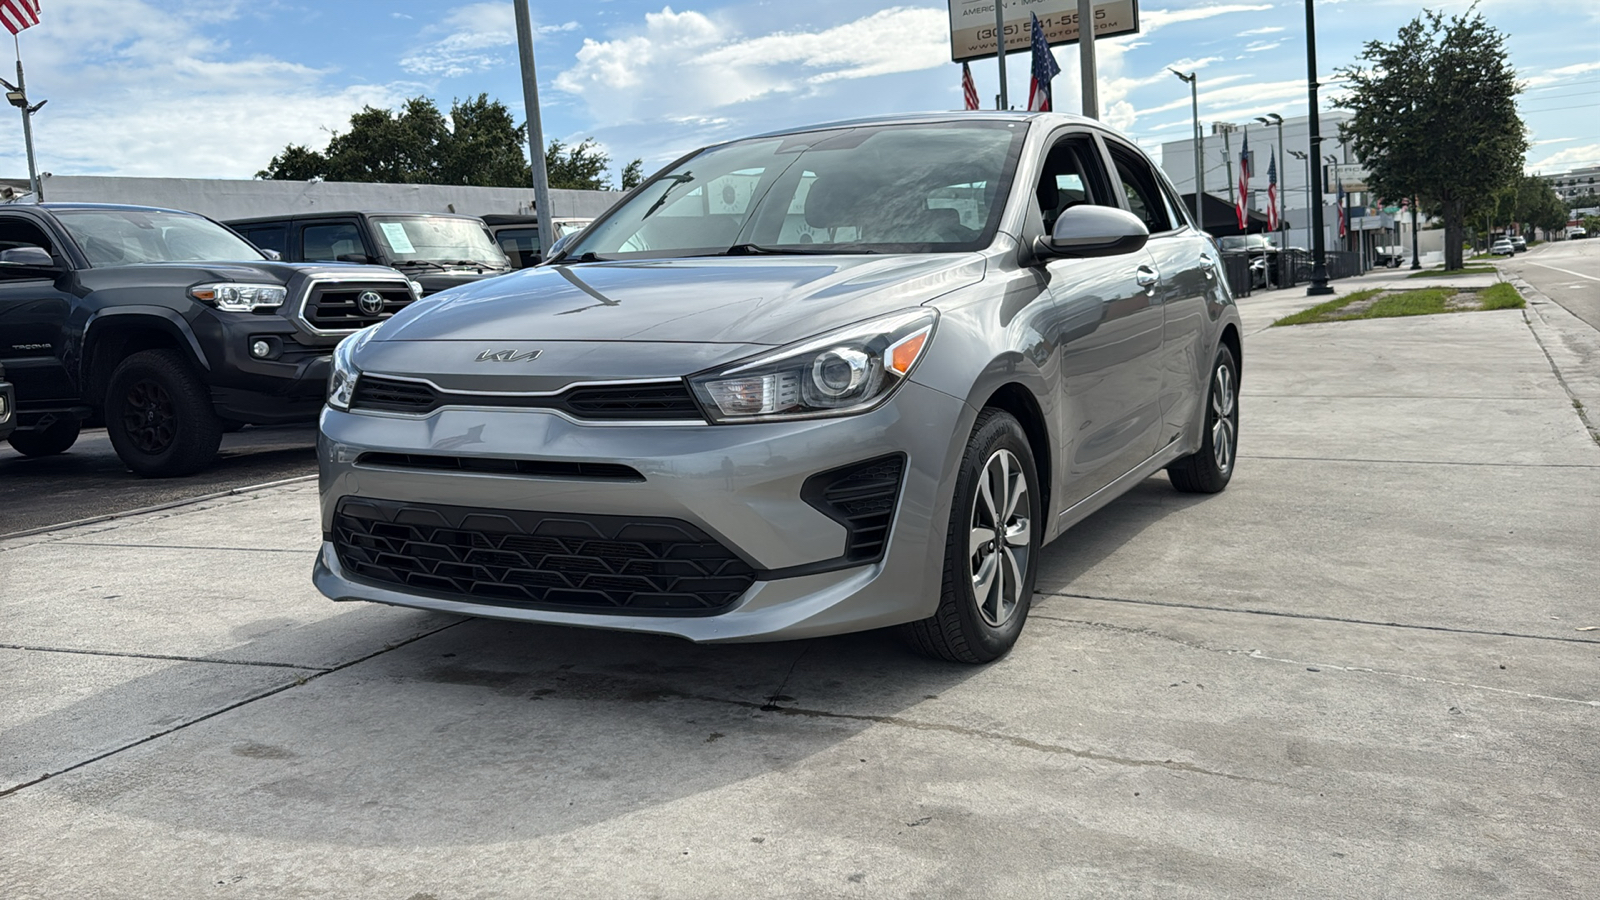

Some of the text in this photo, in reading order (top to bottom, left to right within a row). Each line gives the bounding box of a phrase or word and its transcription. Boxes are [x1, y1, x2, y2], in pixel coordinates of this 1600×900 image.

[962, 2, 1008, 16] AMERICN
[1023, 9, 1106, 32] 541-555
[474, 348, 543, 362] KIA
